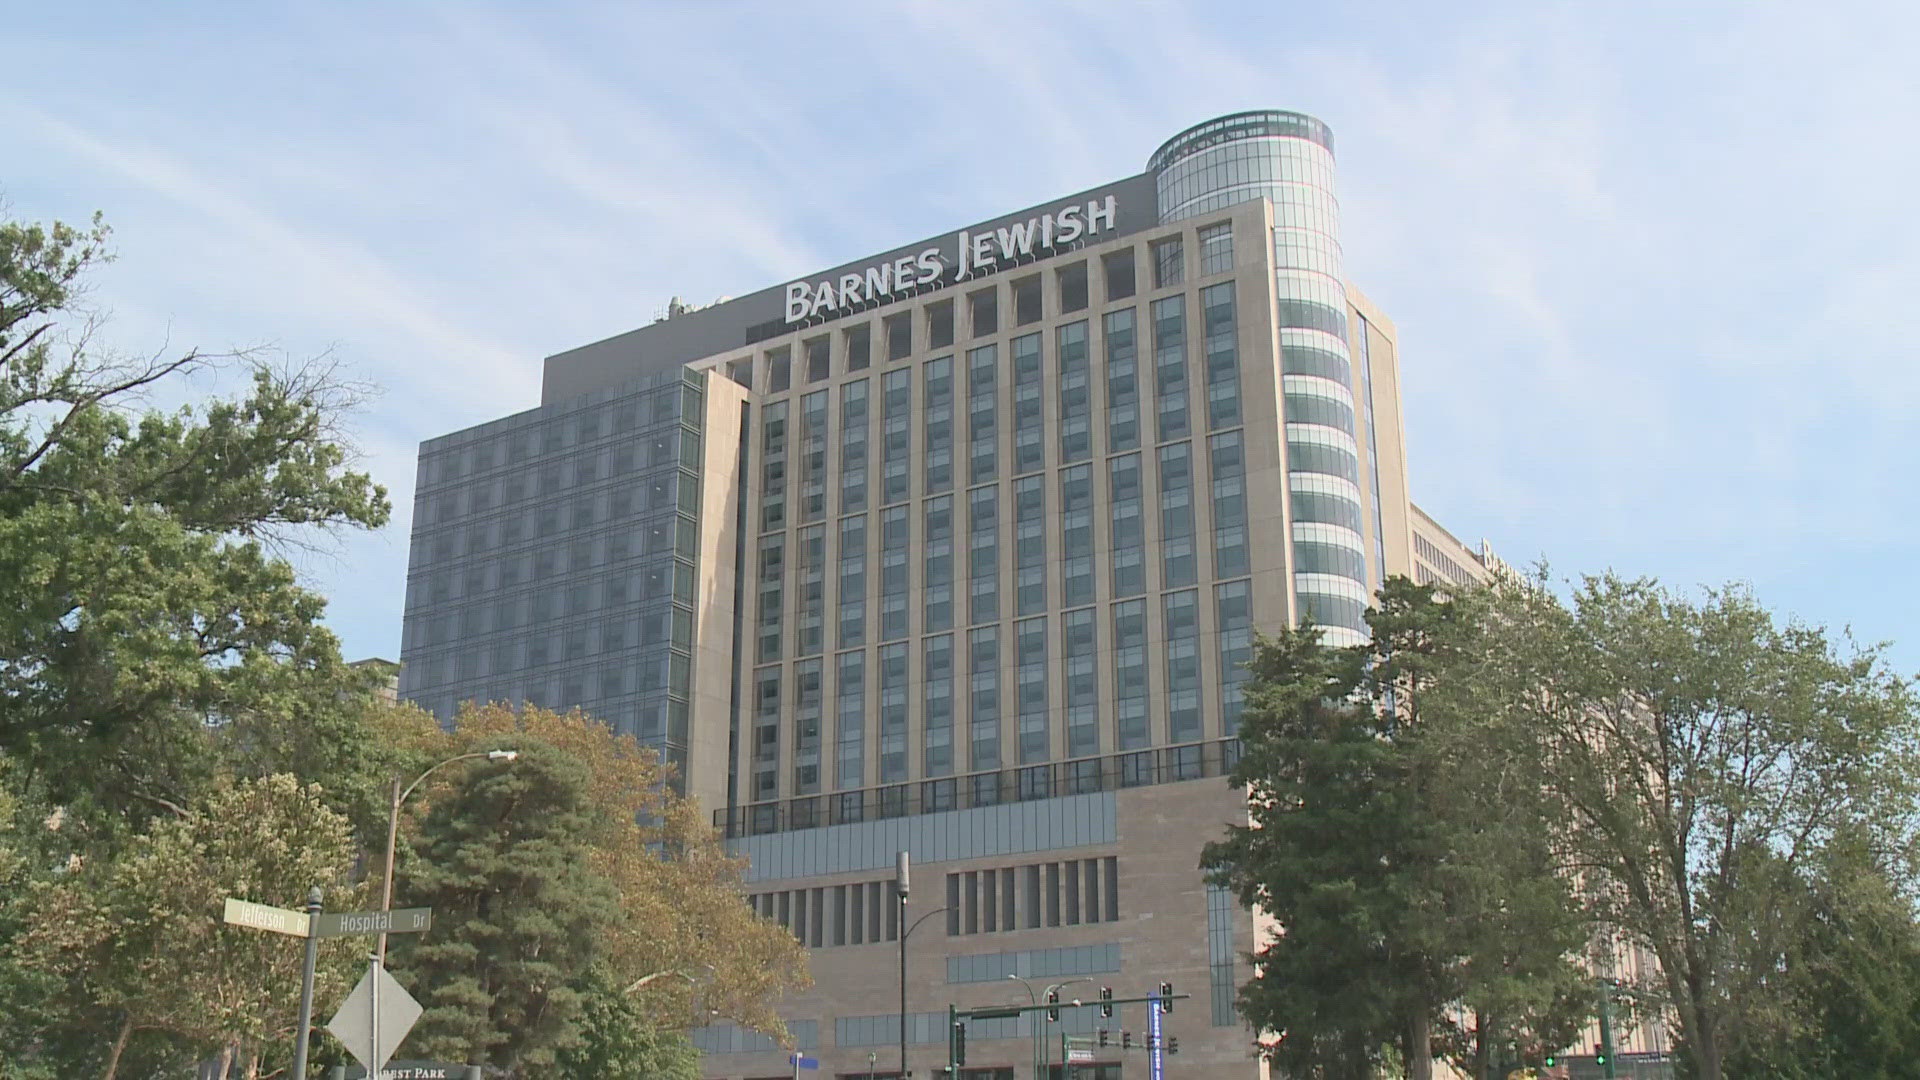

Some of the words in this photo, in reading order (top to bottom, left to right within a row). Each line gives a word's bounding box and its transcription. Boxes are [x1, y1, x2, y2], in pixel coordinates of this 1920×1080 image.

[785, 248, 943, 324] BARNES
[954, 195, 1117, 282] JEWISH
[240, 904, 285, 930] Jefferson
[296, 917, 306, 933] Dr
[340, 910, 393, 934] Hospital
[412, 913, 426, 929] Dr
[414, 1067, 446, 1079] PARK
